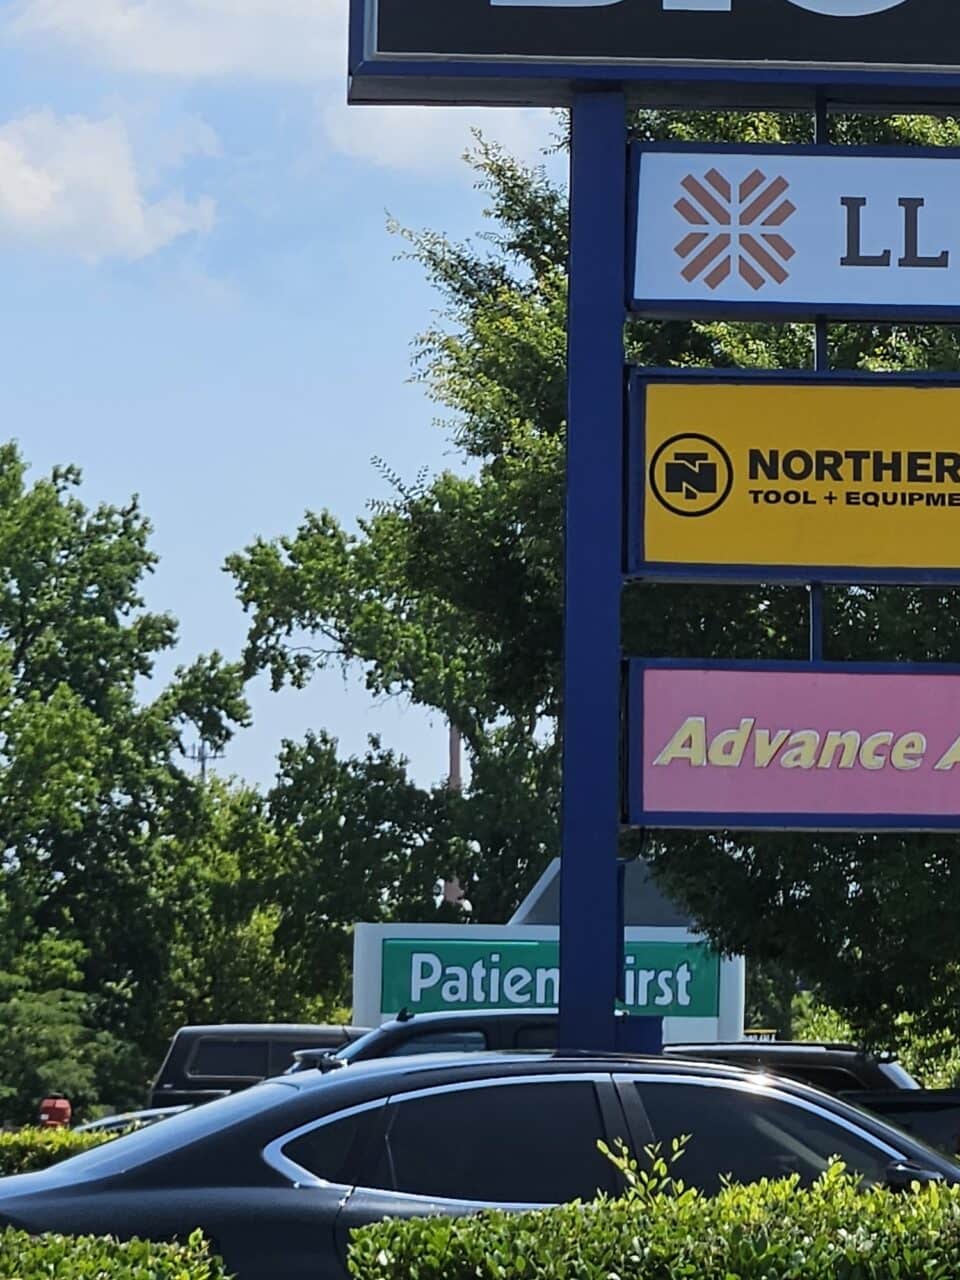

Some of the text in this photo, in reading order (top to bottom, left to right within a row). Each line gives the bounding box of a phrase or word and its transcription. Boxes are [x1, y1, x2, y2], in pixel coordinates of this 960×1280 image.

[839, 196, 950, 268] LL
[749, 489, 816, 505] TOOL
[652, 716, 927, 770] Advance
[411, 952, 691, 1006] Patien irst
